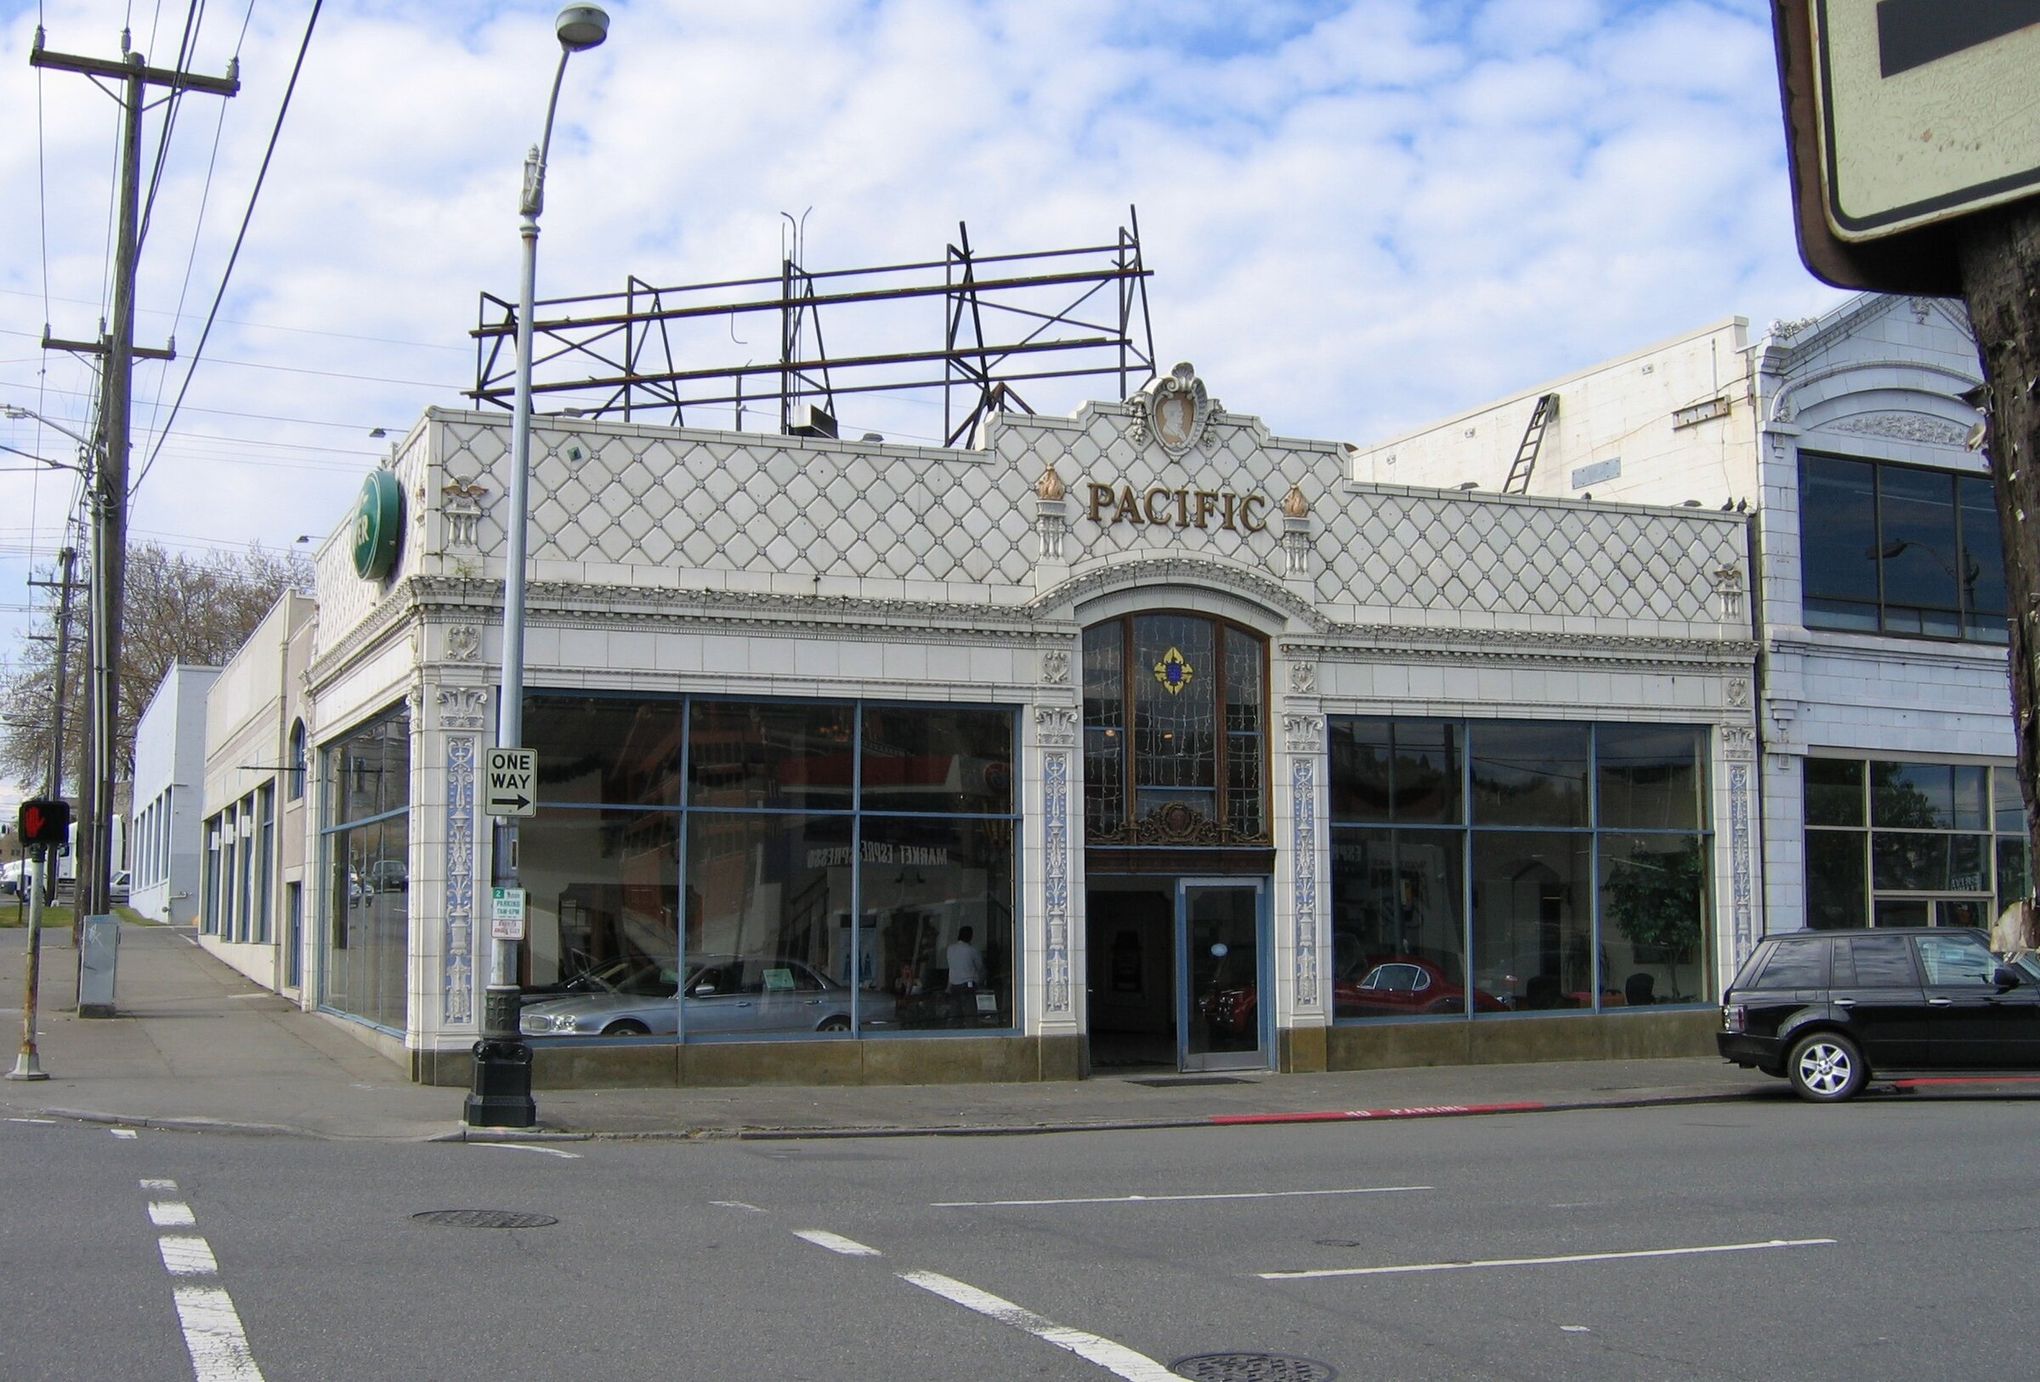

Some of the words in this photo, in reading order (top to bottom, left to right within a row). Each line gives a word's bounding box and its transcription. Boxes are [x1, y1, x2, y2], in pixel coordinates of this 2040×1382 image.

[1087, 482, 1267, 532] PACIFIC
[492, 754, 531, 770] ONE
[491, 773, 531, 789] WAY
